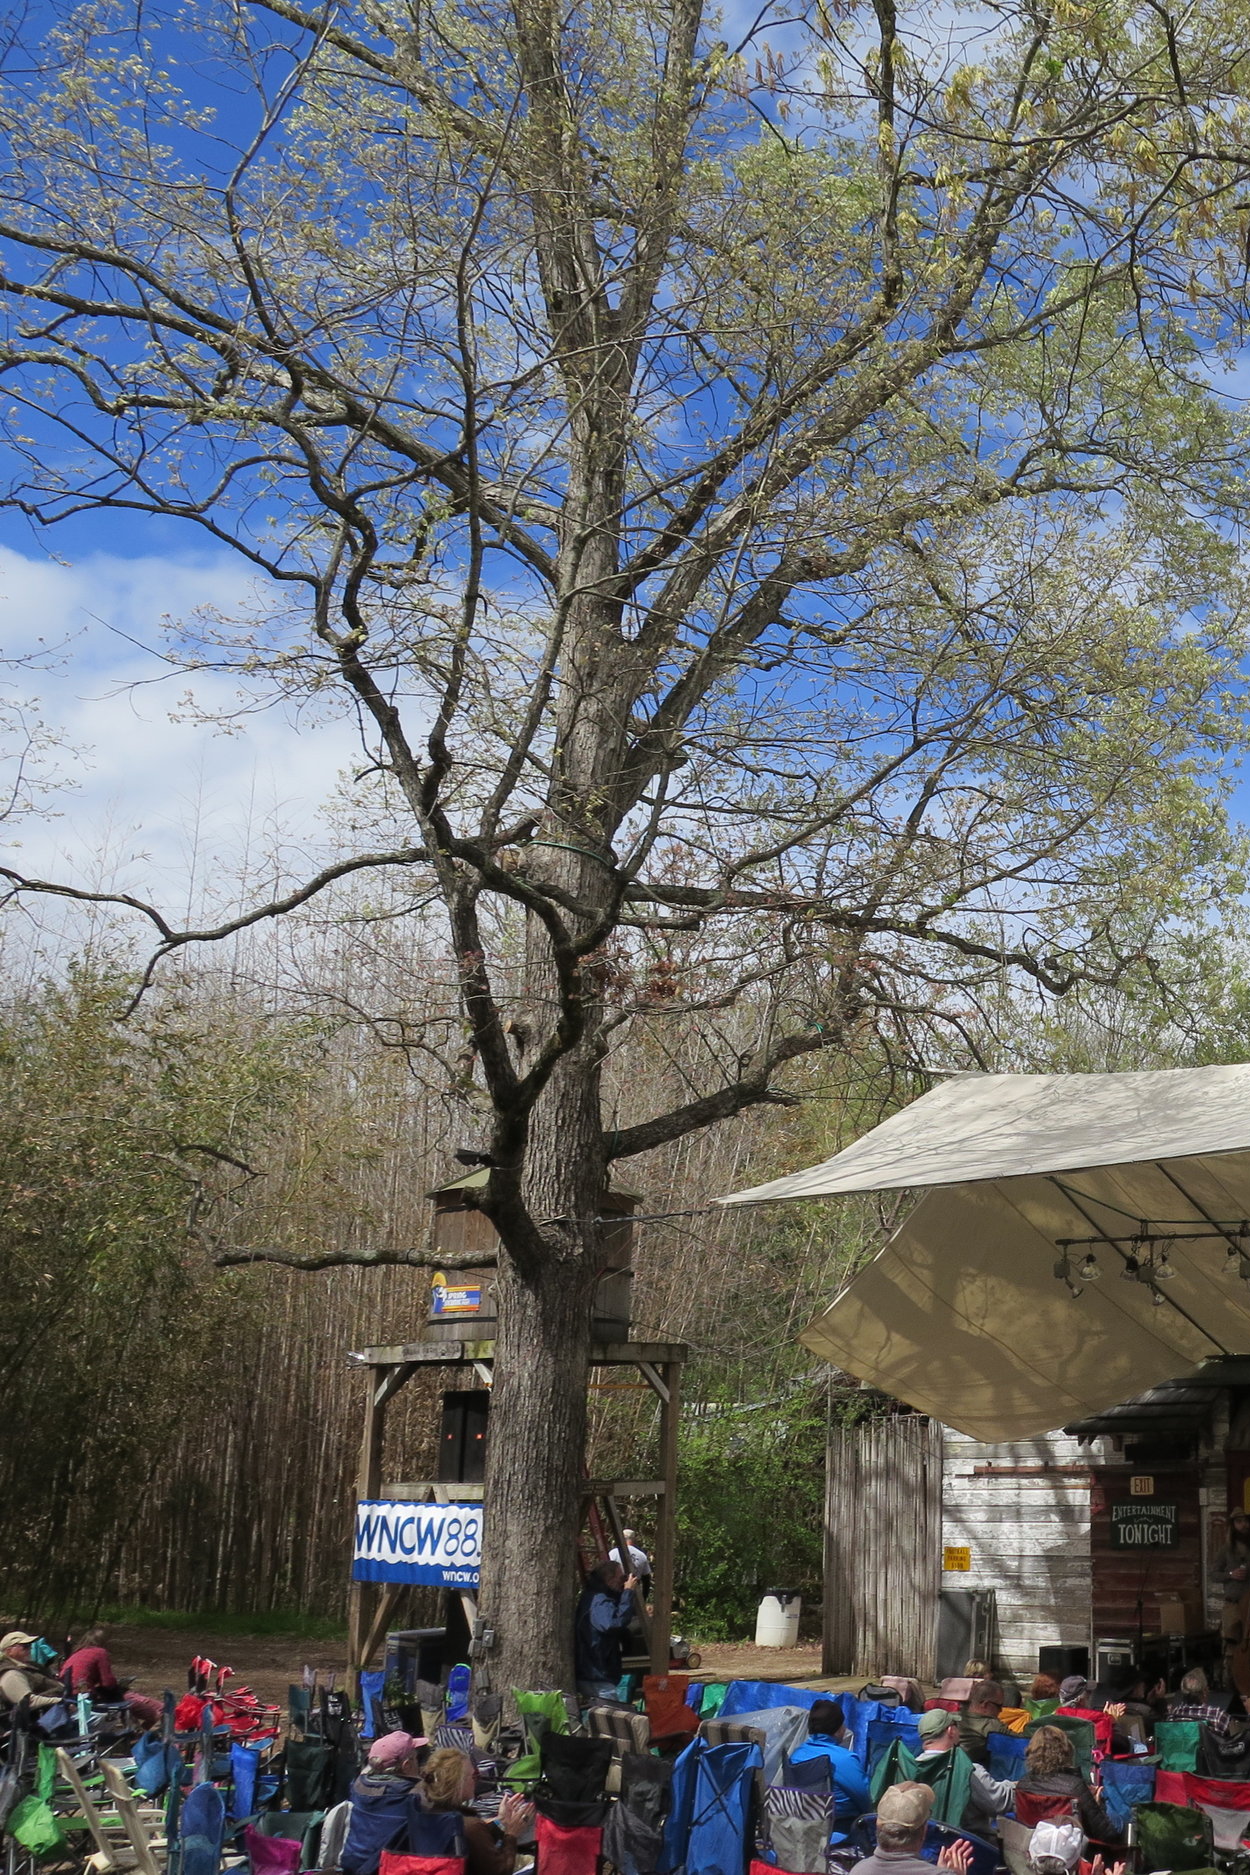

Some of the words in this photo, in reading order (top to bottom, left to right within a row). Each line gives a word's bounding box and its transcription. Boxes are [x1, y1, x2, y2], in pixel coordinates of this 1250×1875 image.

[1134, 1477, 1151, 1493] EXIT
[1112, 1506, 1176, 1523] ENTERTAINMENT
[1118, 1524, 1172, 1544] TONIGHT
